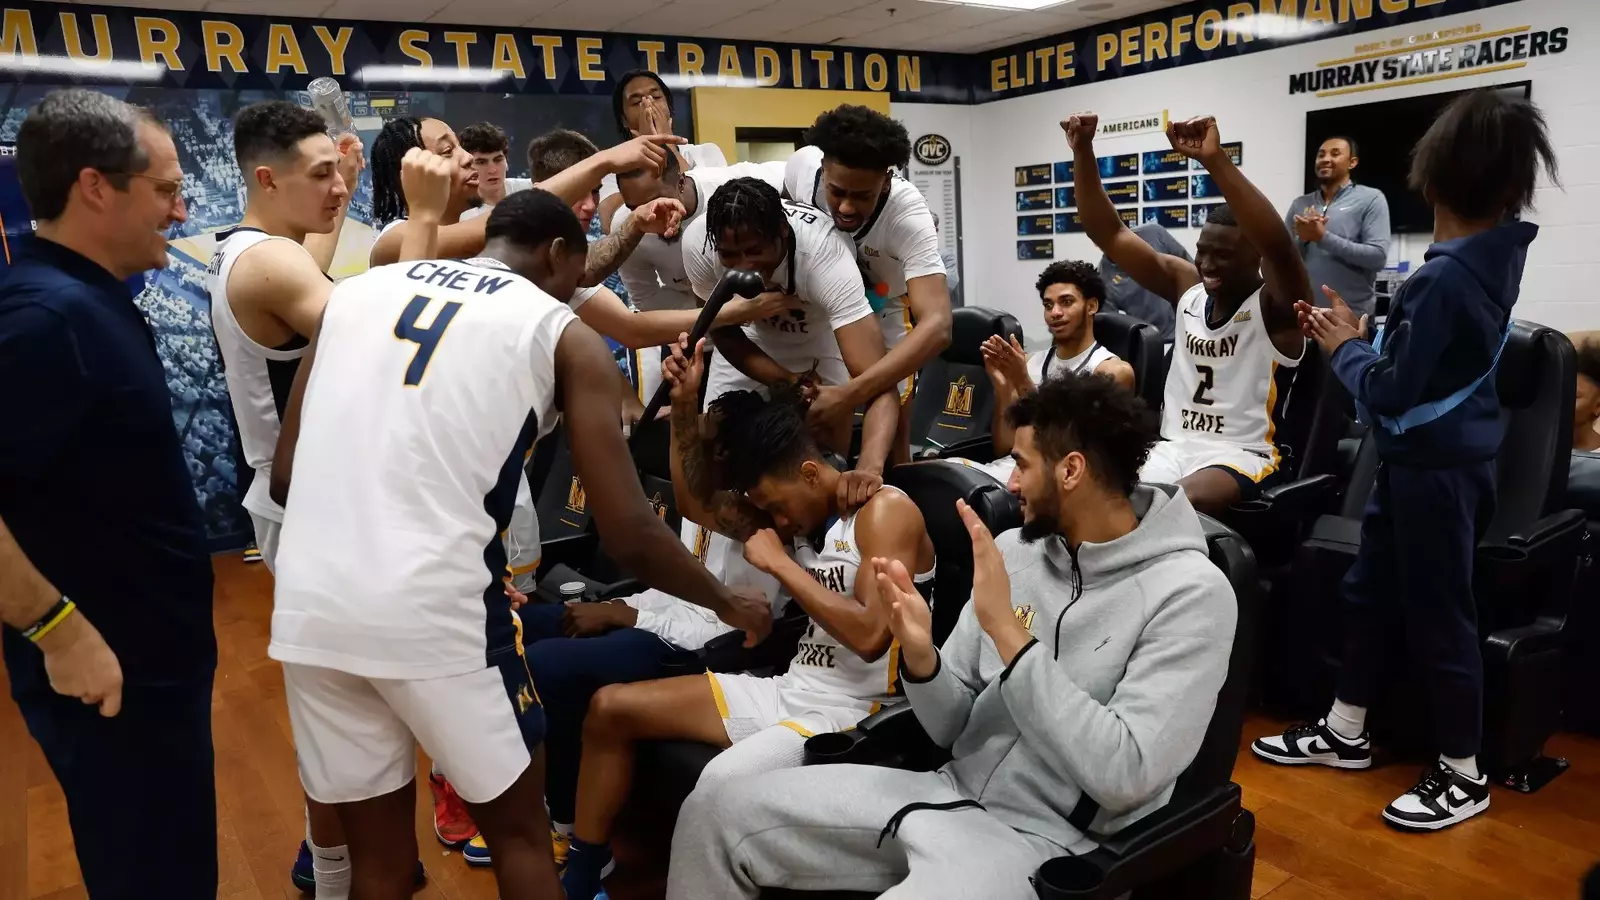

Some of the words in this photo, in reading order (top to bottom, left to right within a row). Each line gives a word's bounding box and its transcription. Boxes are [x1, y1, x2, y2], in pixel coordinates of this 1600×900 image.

[0, 8, 354, 76] MURRAY
[398, 29, 606, 81] STATE
[637, 40, 921, 93] TRADITION
[991, 41, 1076, 93] ELITE
[1097, 0, 1447, 72] PERFORMAN
[1289, 58, 1380, 95] MURRAY
[1382, 48, 1454, 80] STATE
[1457, 26, 1569, 69] RACERS
[1103, 118, 1159, 134] AMERICANS
[921, 143, 944, 157] OVC
[406, 262, 515, 295] CHEW
[394, 293, 464, 387] 4
[1192, 363, 1215, 406] 2
[1181, 408, 1226, 435] STATE
